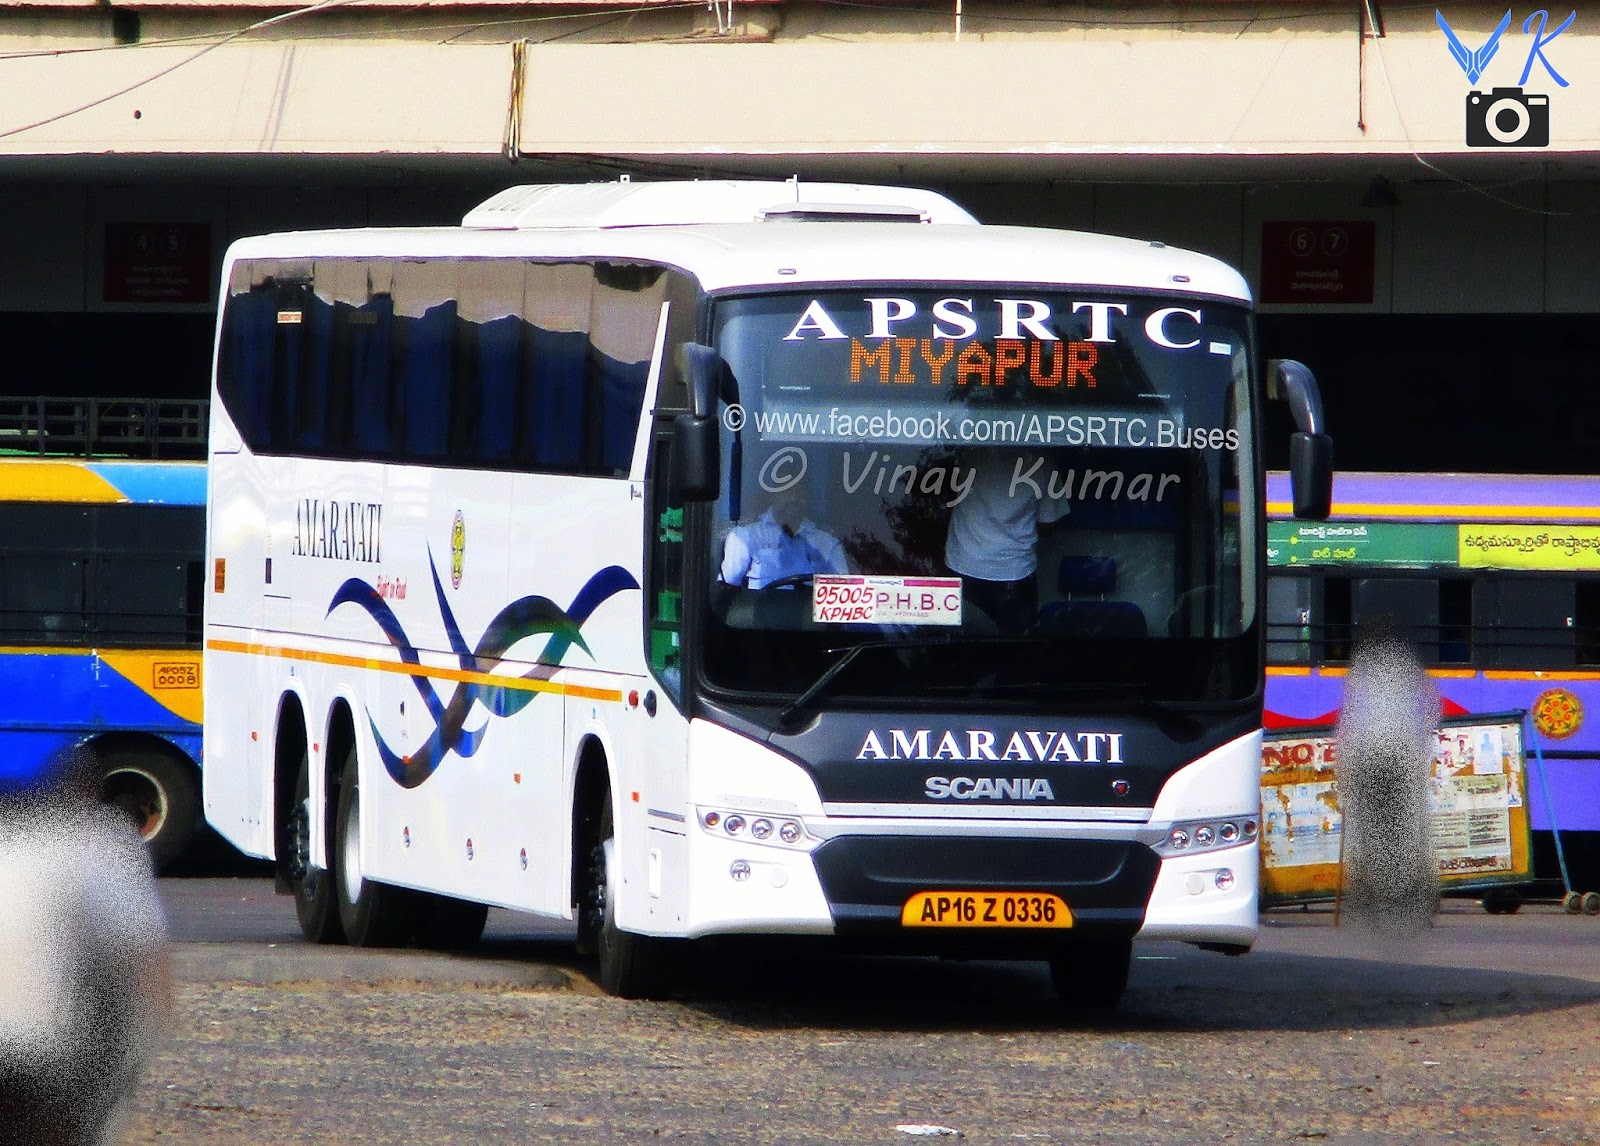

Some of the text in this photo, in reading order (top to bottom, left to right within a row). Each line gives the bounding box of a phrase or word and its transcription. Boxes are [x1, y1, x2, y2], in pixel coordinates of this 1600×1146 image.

[783, 298, 1203, 349] APSRTC
[850, 337, 1099, 388] MIYAPUR
[292, 498, 383, 564] AMARAVATI
[815, 585, 874, 605] 95005
[819, 606, 873, 621] KPHBC
[856, 729, 1124, 764] AMARAVATI
[925, 776, 1055, 800] SCANIA
[921, 897, 1056, 923] AP16 Z 0336
